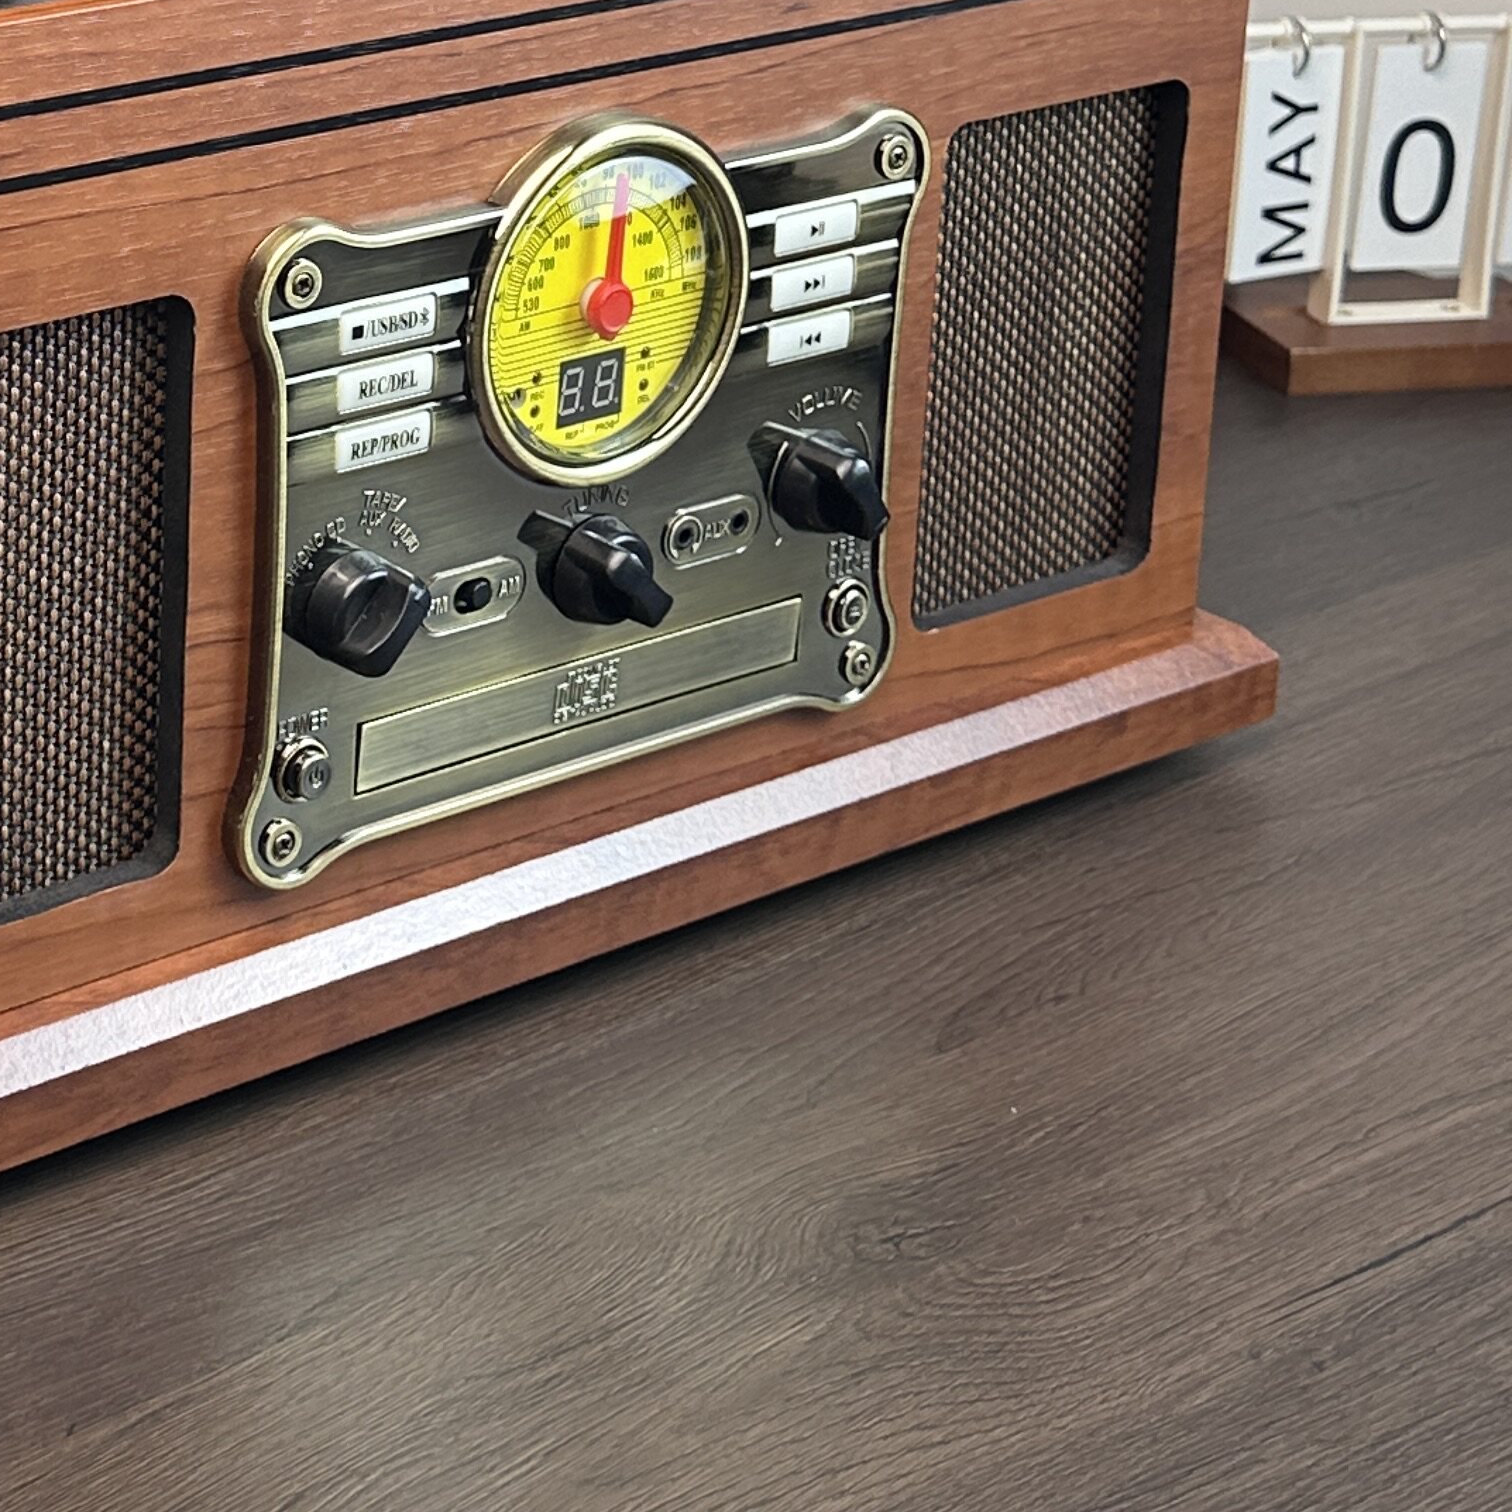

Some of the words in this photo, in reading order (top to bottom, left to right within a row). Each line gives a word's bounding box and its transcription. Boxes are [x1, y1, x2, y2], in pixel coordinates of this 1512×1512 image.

[1255, 90, 1320, 266] MAY
[523, 296, 540, 313] 530
[359, 370, 418, 400] REC/DEL
[351, 427, 421, 461] REP/PROG
[704, 521, 731, 540] AUX
[498, 575, 521, 597] AM
